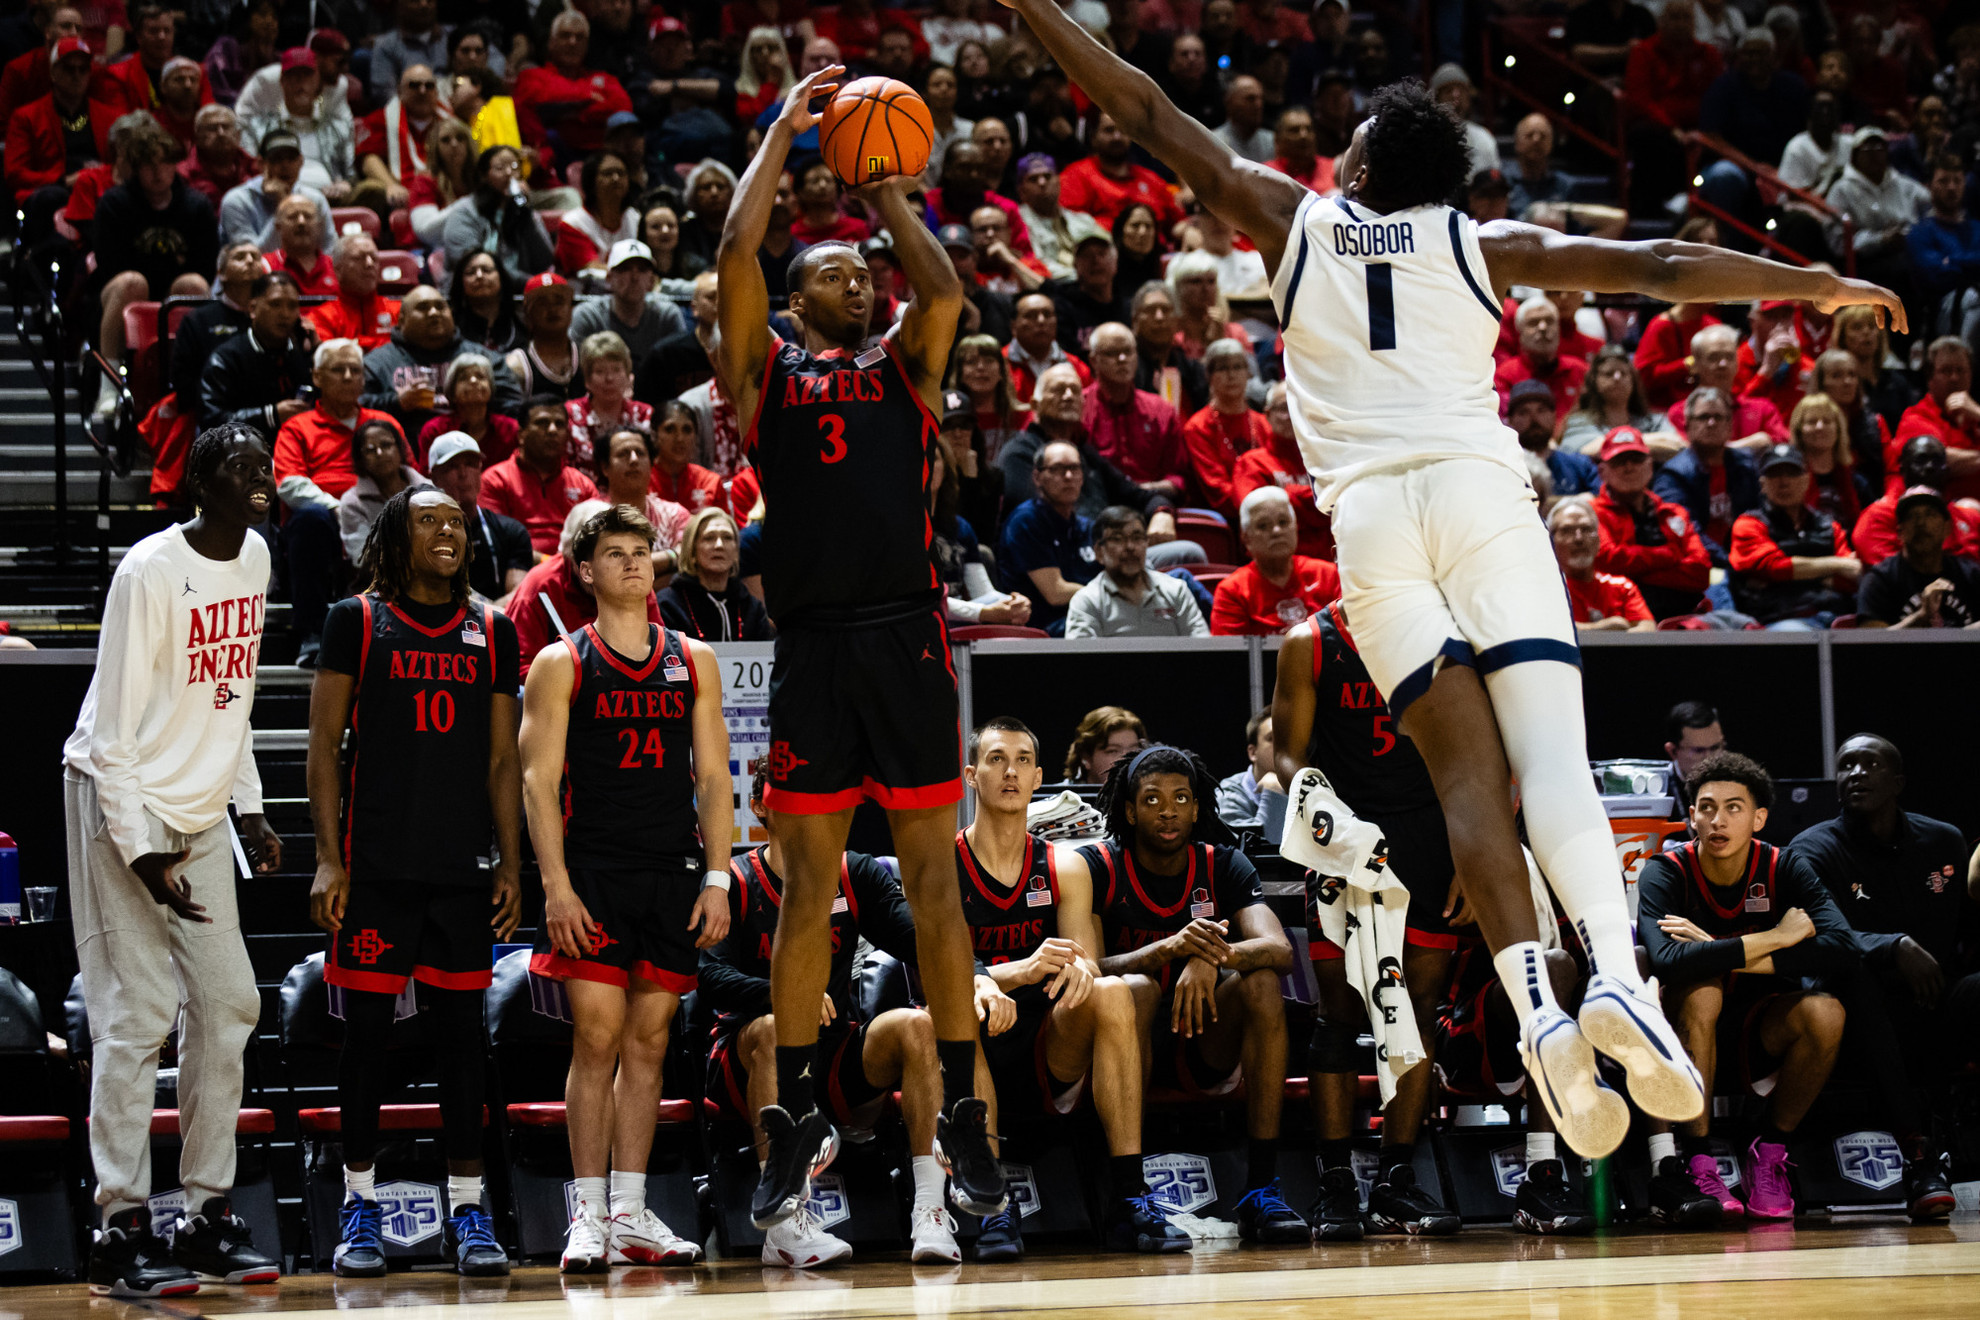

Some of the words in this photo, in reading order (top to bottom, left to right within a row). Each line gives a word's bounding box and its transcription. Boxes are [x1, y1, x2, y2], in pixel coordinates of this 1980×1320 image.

[1333, 222, 1415, 256] OSOBOR
[1365, 262, 1397, 351] 1
[782, 369, 884, 408] AZTECS
[818, 414, 848, 464] 3
[389, 650, 478, 684] AZTECS
[413, 689, 455, 733] 10
[594, 690, 685, 719] AZTECS
[618, 728, 666, 769] 24
[1372, 715, 1396, 757] 5
[1842, 1145, 1902, 1170] 25
[1145, 1168, 1209, 1194] 25
[377, 1197, 436, 1225] 25
